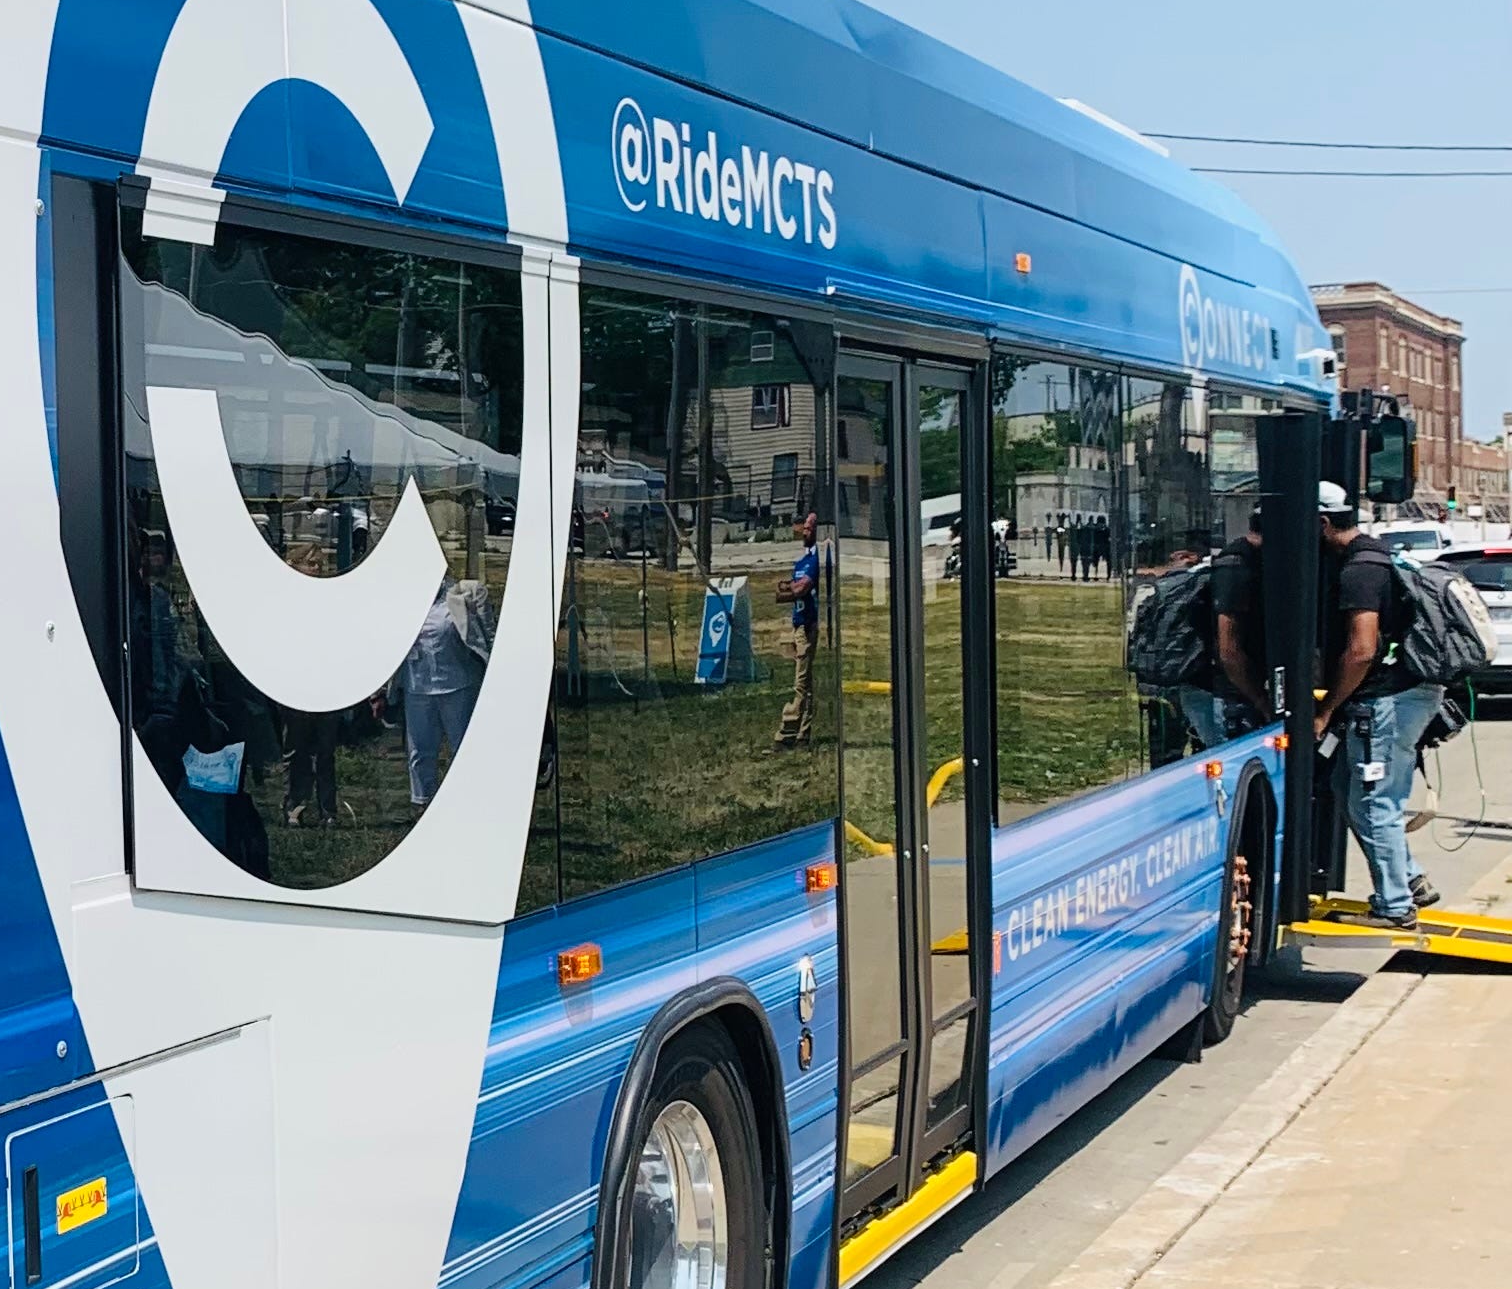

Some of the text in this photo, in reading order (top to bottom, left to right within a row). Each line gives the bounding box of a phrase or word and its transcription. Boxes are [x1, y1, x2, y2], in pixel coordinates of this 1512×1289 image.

[612, 97, 837, 249] @RideMCTS
[1007, 815, 1221, 961] CLEAN ENERGY. CLEAN AIR.
